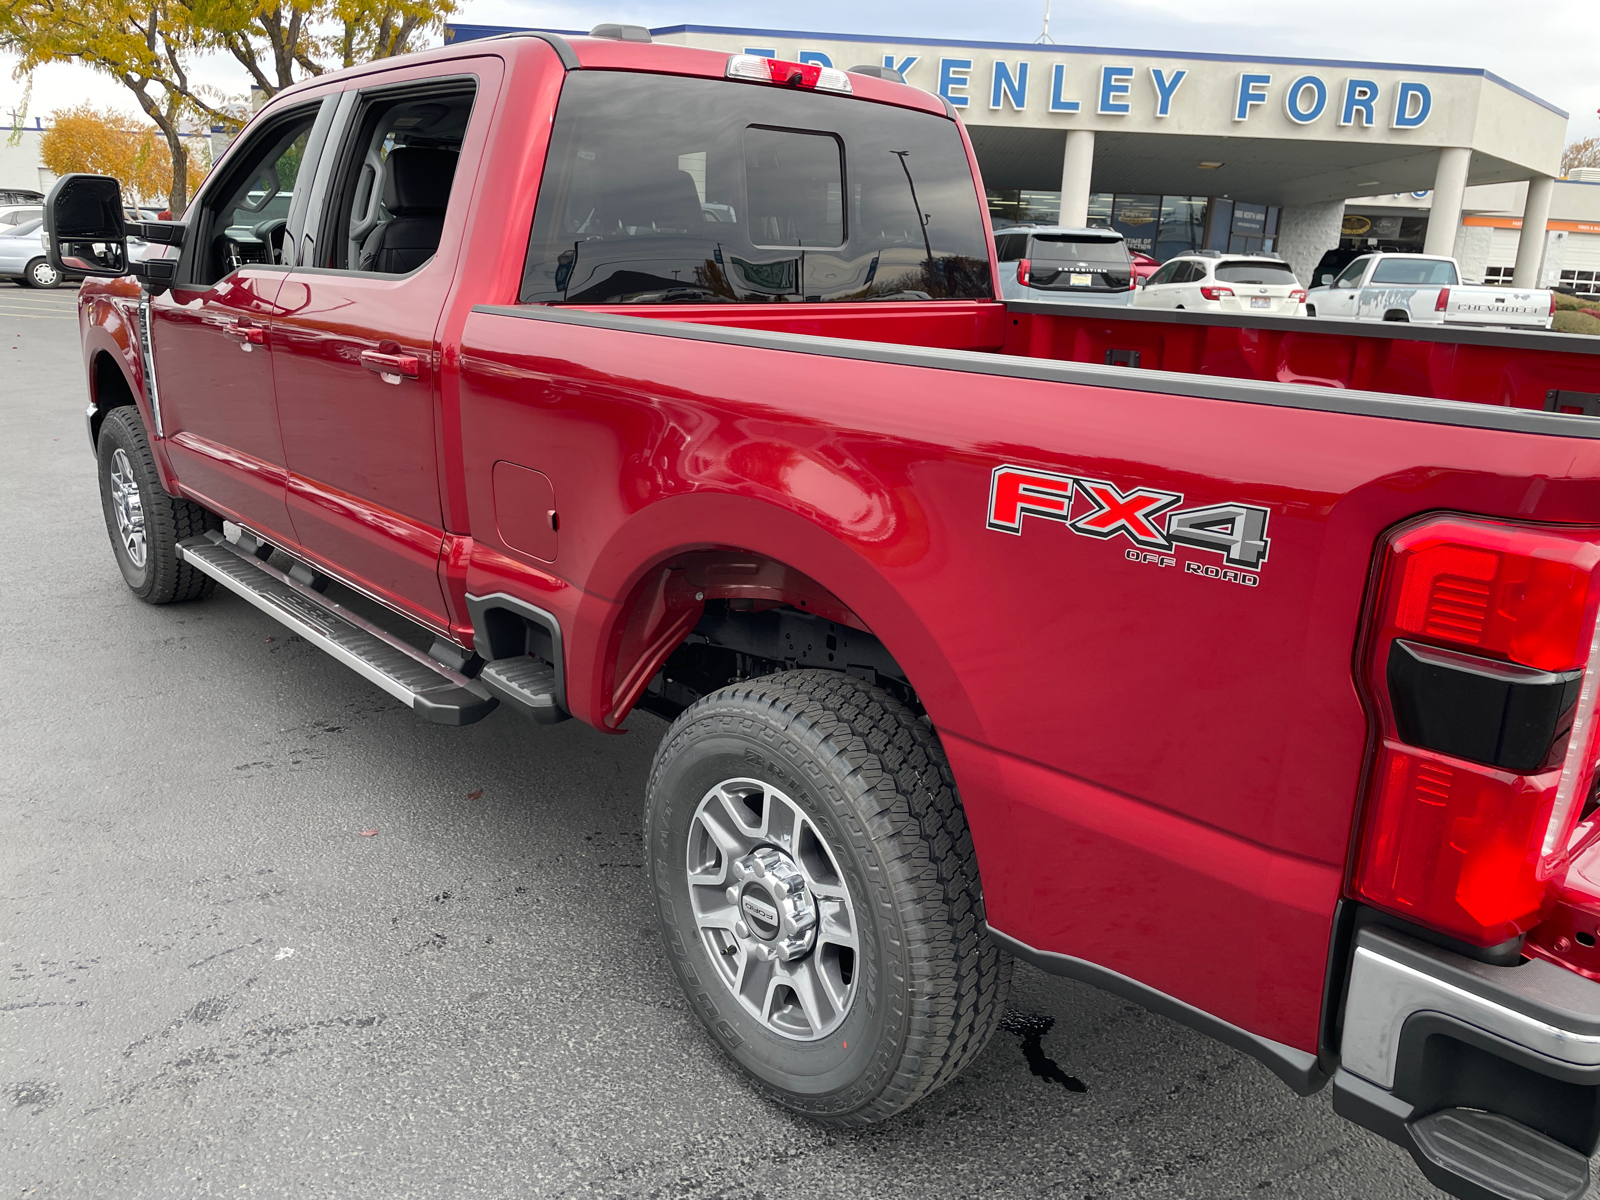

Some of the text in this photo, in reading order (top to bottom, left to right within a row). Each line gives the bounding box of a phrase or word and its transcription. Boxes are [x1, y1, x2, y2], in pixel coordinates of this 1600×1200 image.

[1232, 72, 1433, 130] FORD
[1457, 303, 1538, 314] CHEVROLET
[986, 463, 1271, 572] FX4
[1125, 548, 1260, 587] OFF ROAD
[745, 902, 774, 920] FORD
